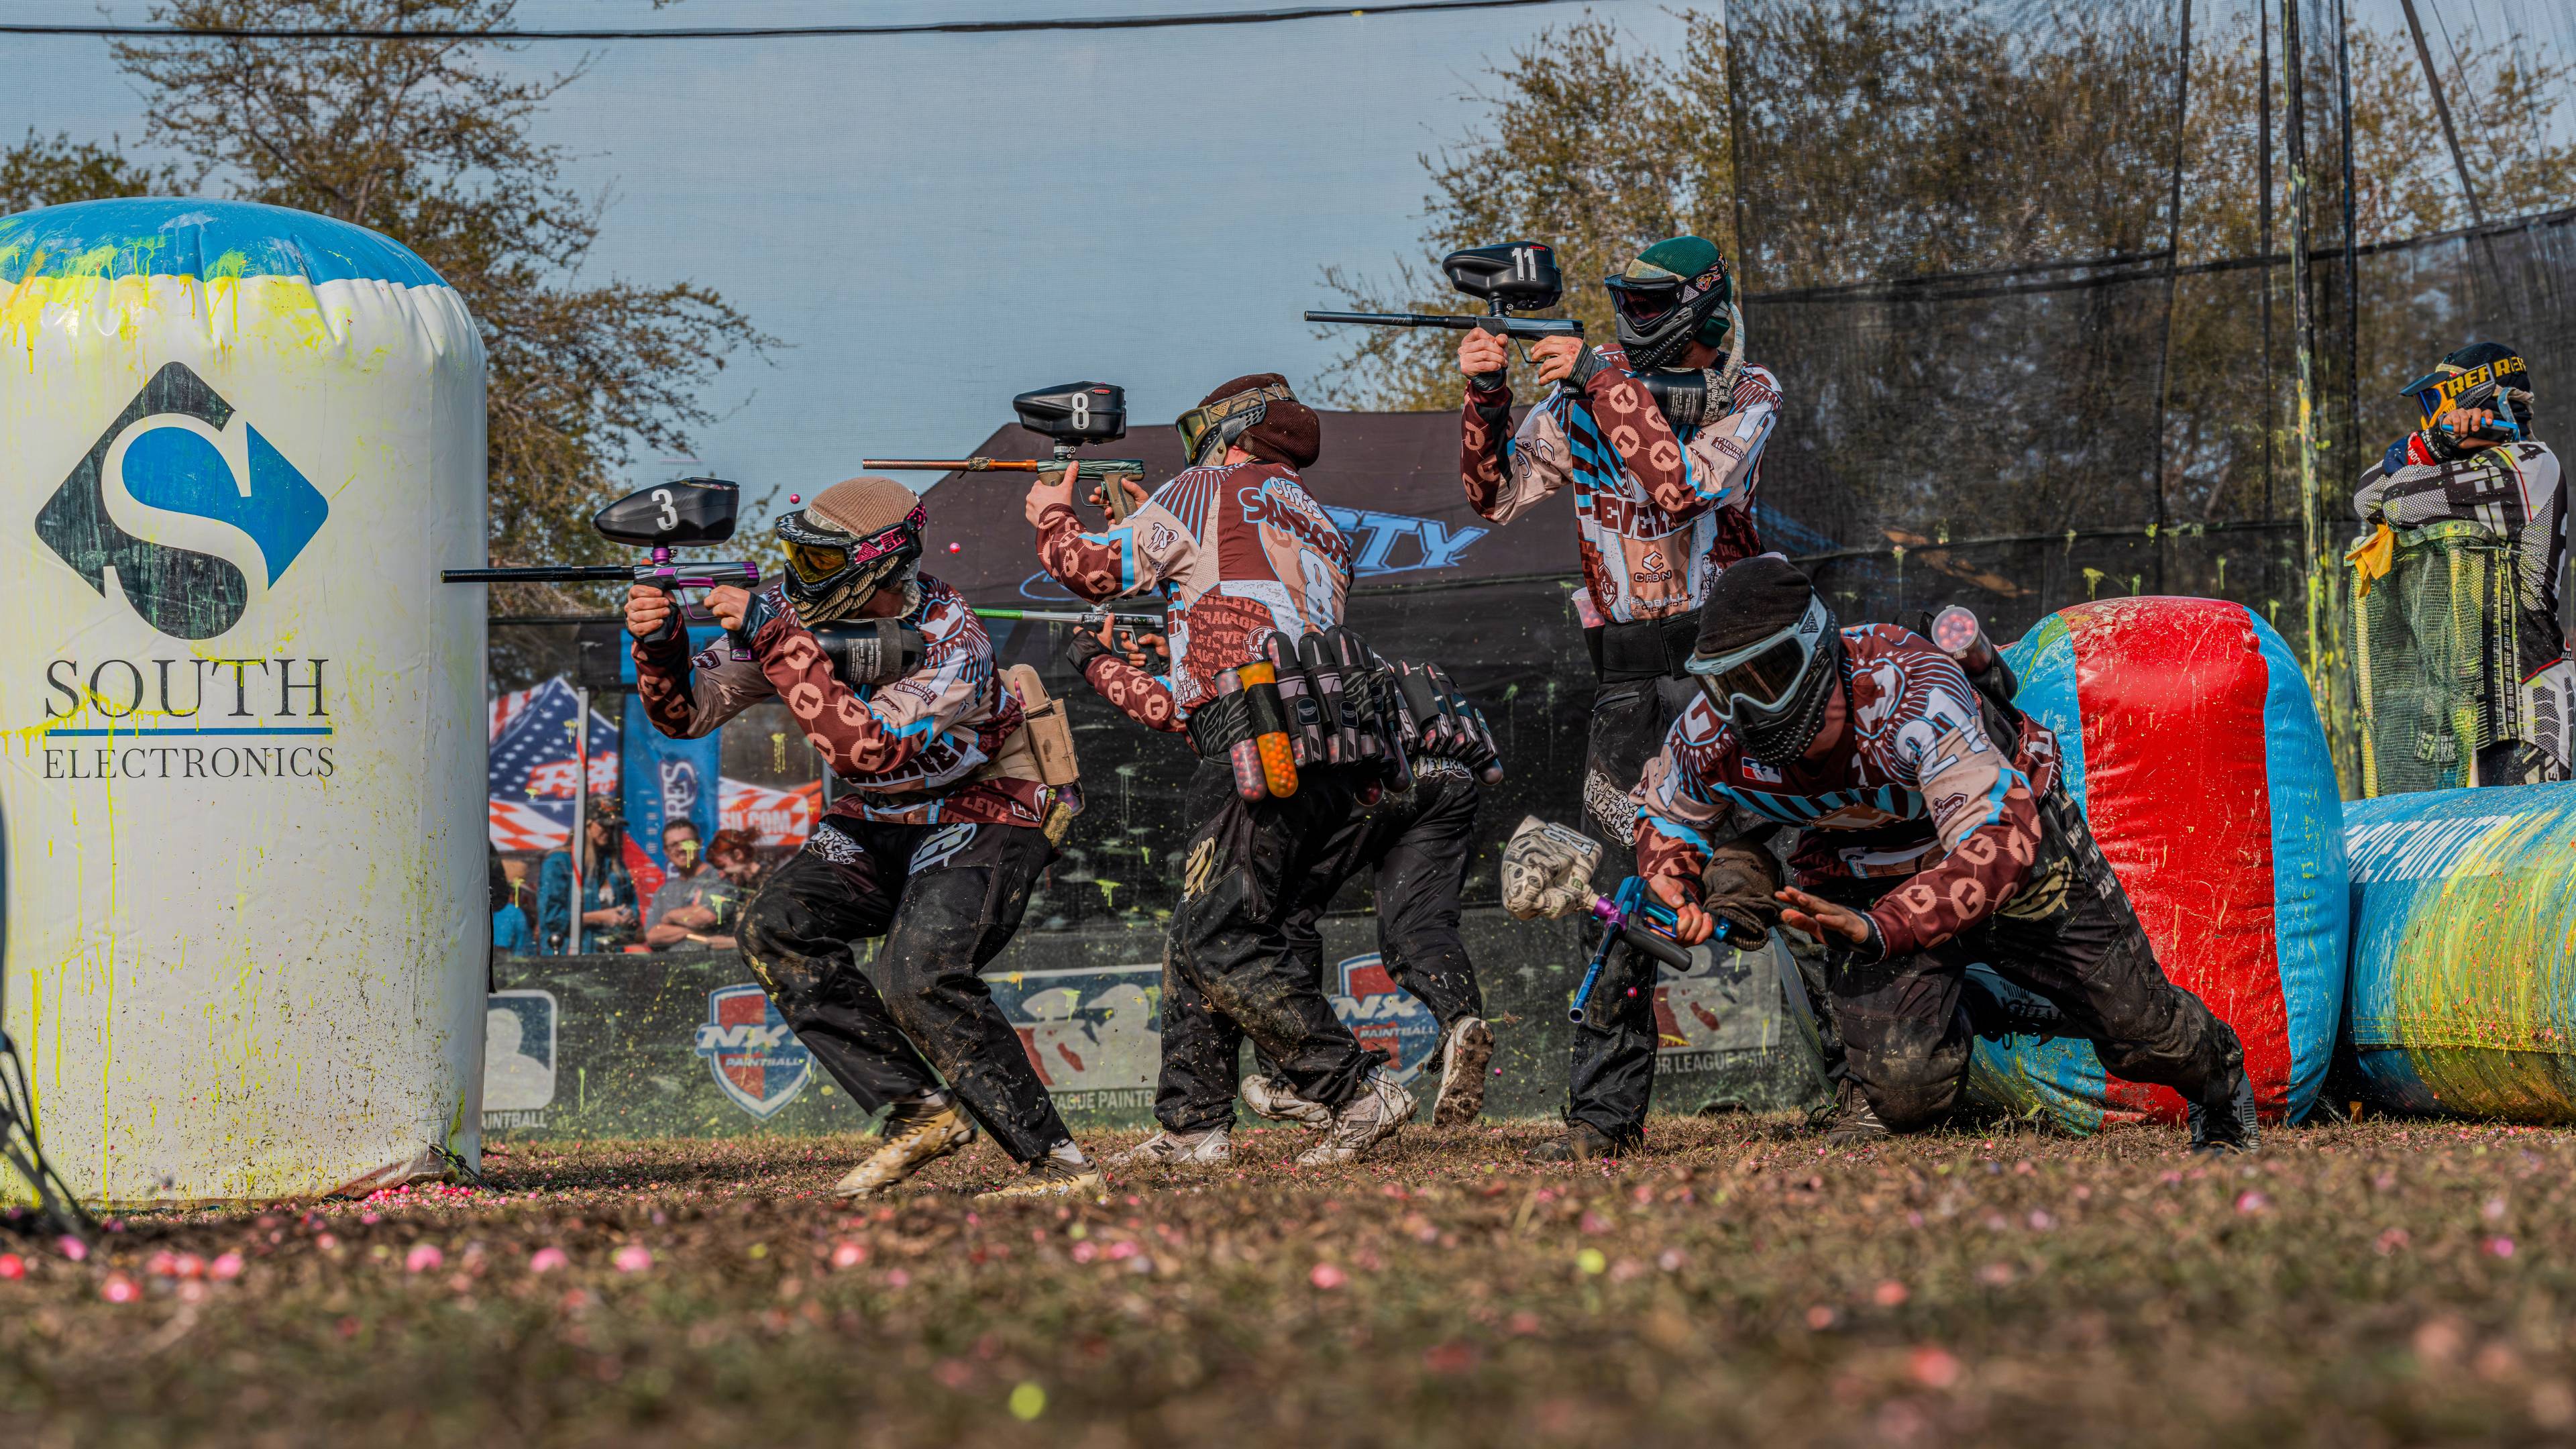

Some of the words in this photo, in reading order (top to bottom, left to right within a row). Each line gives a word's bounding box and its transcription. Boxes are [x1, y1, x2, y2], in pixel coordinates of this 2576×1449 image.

[1511, 248, 1537, 282] 11
[2447, 366, 2489, 398] REF
[1071, 392, 1089, 430] 8
[651, 488, 679, 531] 3
[1269, 476, 1323, 519] CHRIS
[1299, 547, 1334, 629] 8
[1634, 570, 1672, 583] CRBN
[45, 659, 330, 718] SOUTH
[895, 683, 933, 705] AUTHORITY
[900, 676, 935, 700] PAINTBALL
[43, 747, 335, 780] ELECTRONICS
[1330, 994, 1425, 1020] NX
[1359, 1026, 1436, 1040] PAINTBALL
[724, 1057, 803, 1067] PAINTBALL
[1676, 1051, 1736, 1073] LEAGUE
[1049, 1091, 1095, 1112] EAGUE
[1098, 1088, 1155, 1108] PAINTB
[482, 1111, 549, 1130] AINTBALL
